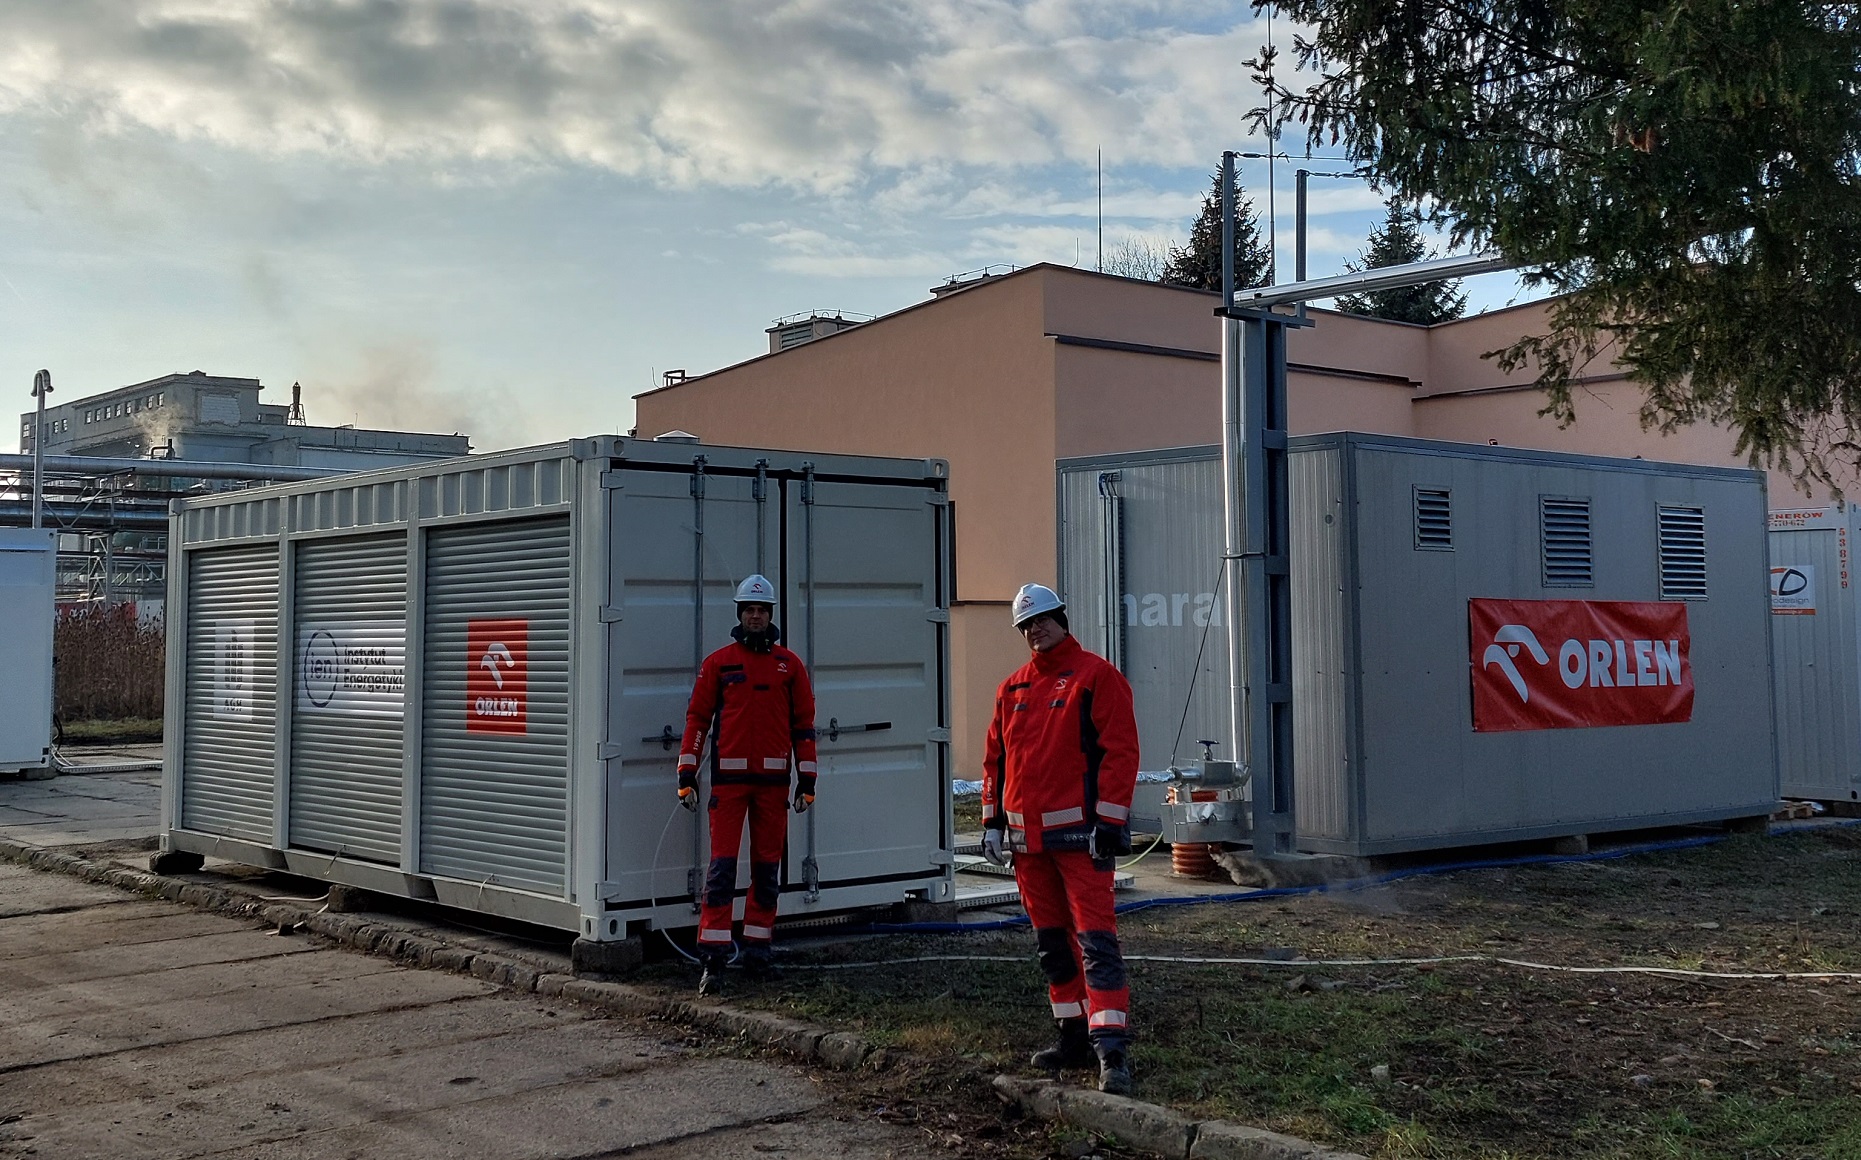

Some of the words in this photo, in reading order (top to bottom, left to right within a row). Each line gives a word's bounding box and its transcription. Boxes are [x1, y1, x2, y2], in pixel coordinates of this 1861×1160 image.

[1559, 639, 1682, 689] ORLEN
[343, 667, 404, 692] Energetyki
[475, 697, 518, 717] ORLEN
